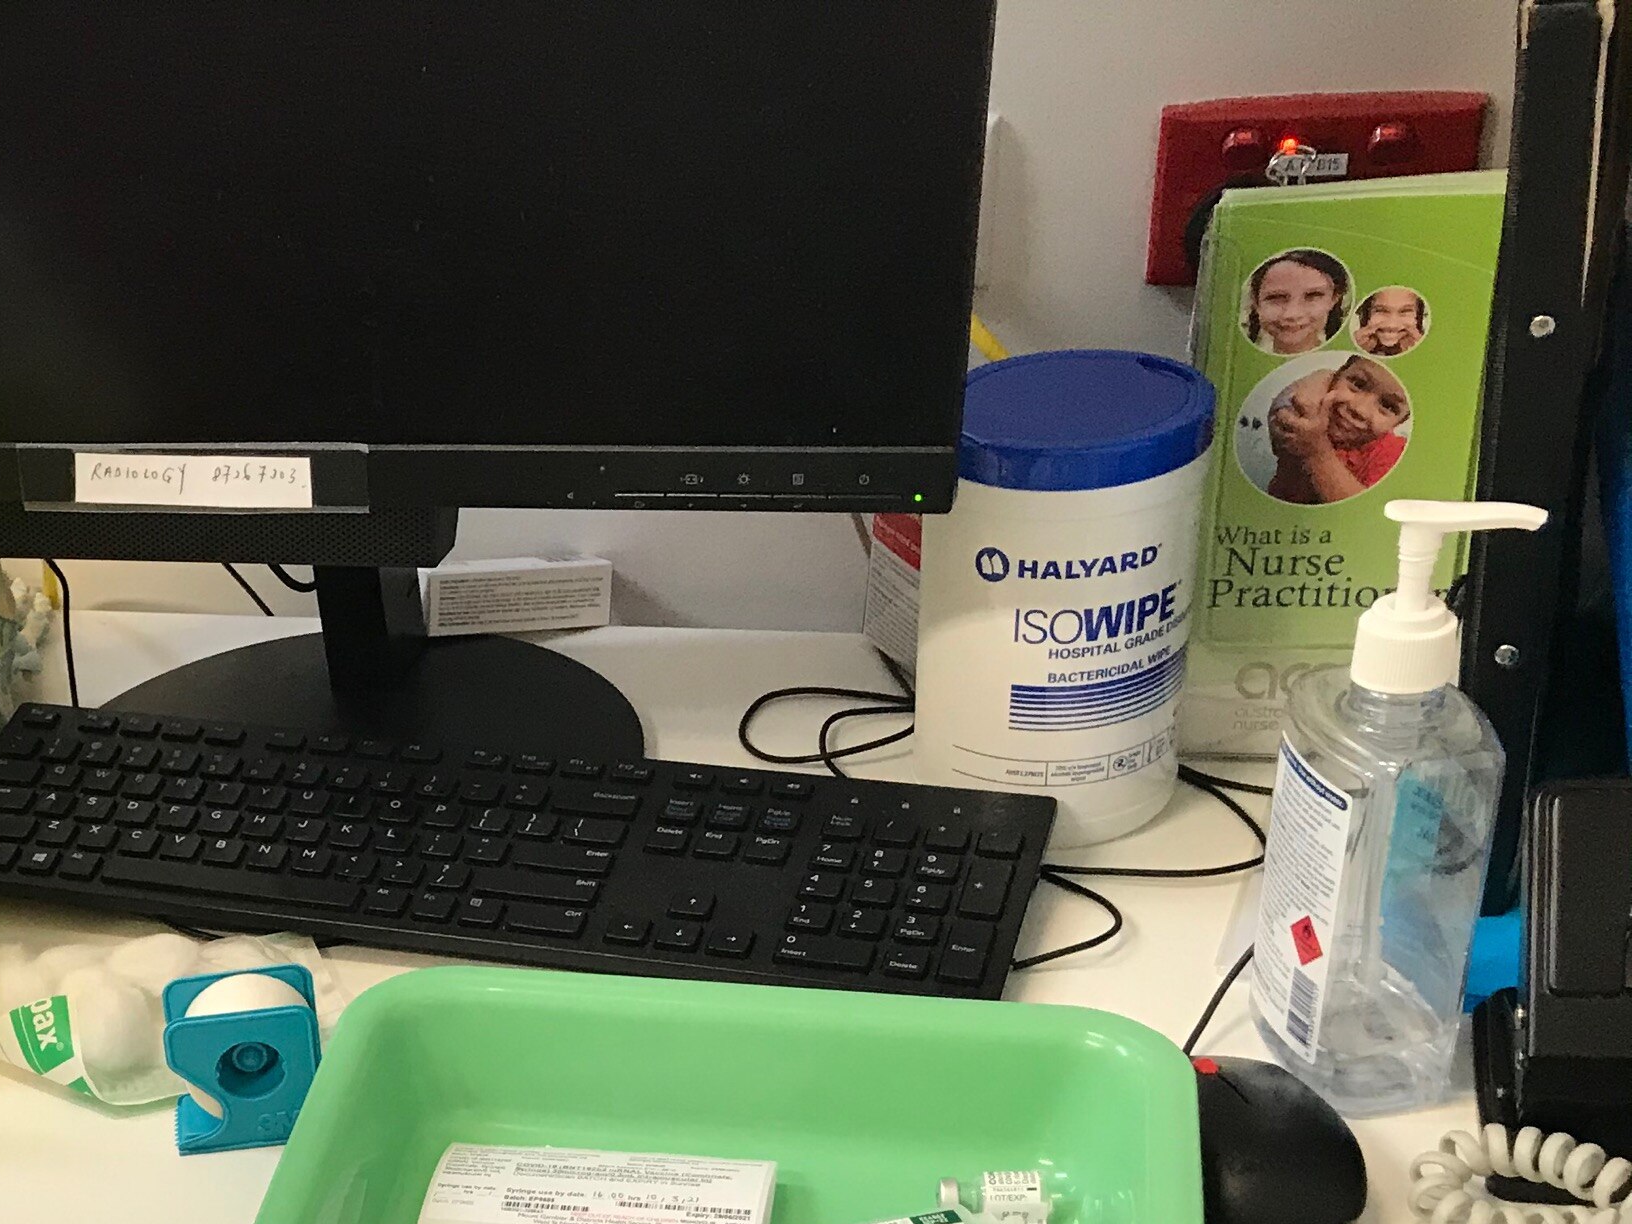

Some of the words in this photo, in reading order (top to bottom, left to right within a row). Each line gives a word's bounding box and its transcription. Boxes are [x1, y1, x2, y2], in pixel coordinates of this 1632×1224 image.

[91, 463, 186, 495] RADIOLOGY
[1217, 525, 1282, 546] What
[1290, 525, 1310, 545] is
[1319, 529, 1332, 545] a
[1018, 546, 1158, 580] HALYARD
[1222, 547, 1345, 578] Nurse
[1013, 583, 1177, 645] ISOWIPE
[1048, 641, 1121, 660] HOSPITAL
[1125, 628, 1165, 650] GRADE
[1048, 660, 1145, 684] BACTERICIDAL
[54, 765, 66, 774] Q
[96, 770, 109, 778] W
[176, 778, 186, 786] R
[219, 783, 228, 791] T
[261, 787, 270, 795] Y
[47, 793, 56, 801] A
[303, 791, 314, 800] U
[88, 797, 97, 805] S
[127, 801, 138, 810] D
[390, 800, 401, 809] O
[169, 805, 180, 814] F
[435, 804, 447, 812] P
[210, 810, 222, 819] G
[254, 815, 266, 823] H
[48, 820, 60, 829] Z
[341, 825, 352, 833] K
[89, 825, 101, 834] X
[387, 829, 395, 838] L
[131, 830, 142, 839] C
[175, 835, 186, 843] V
[216, 840, 227, 848] B
[259, 845, 271, 853] N
[302, 849, 316, 858] M
